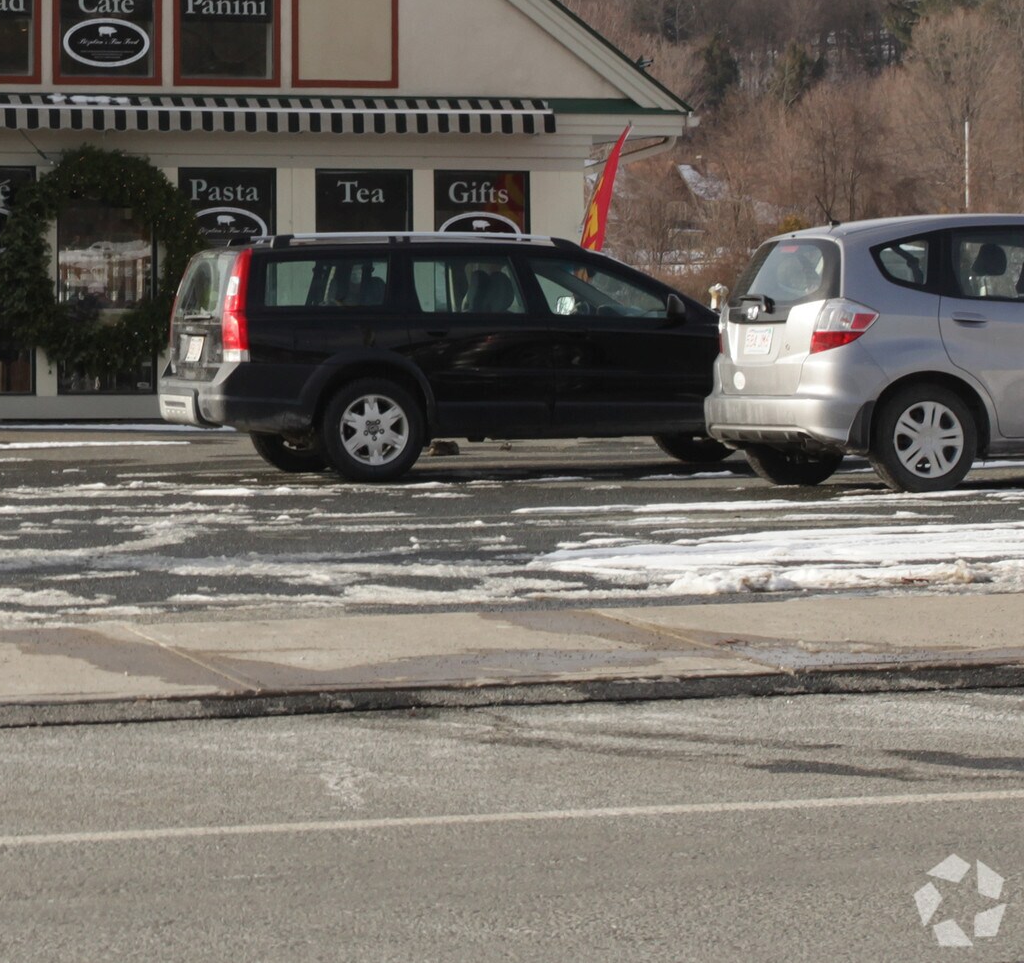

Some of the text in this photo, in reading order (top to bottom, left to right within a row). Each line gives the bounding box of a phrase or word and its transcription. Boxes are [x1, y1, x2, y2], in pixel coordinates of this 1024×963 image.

[189, 178, 259, 201] Pasta
[336, 180, 385, 203] Tea
[448, 181, 509, 204] Gifts
